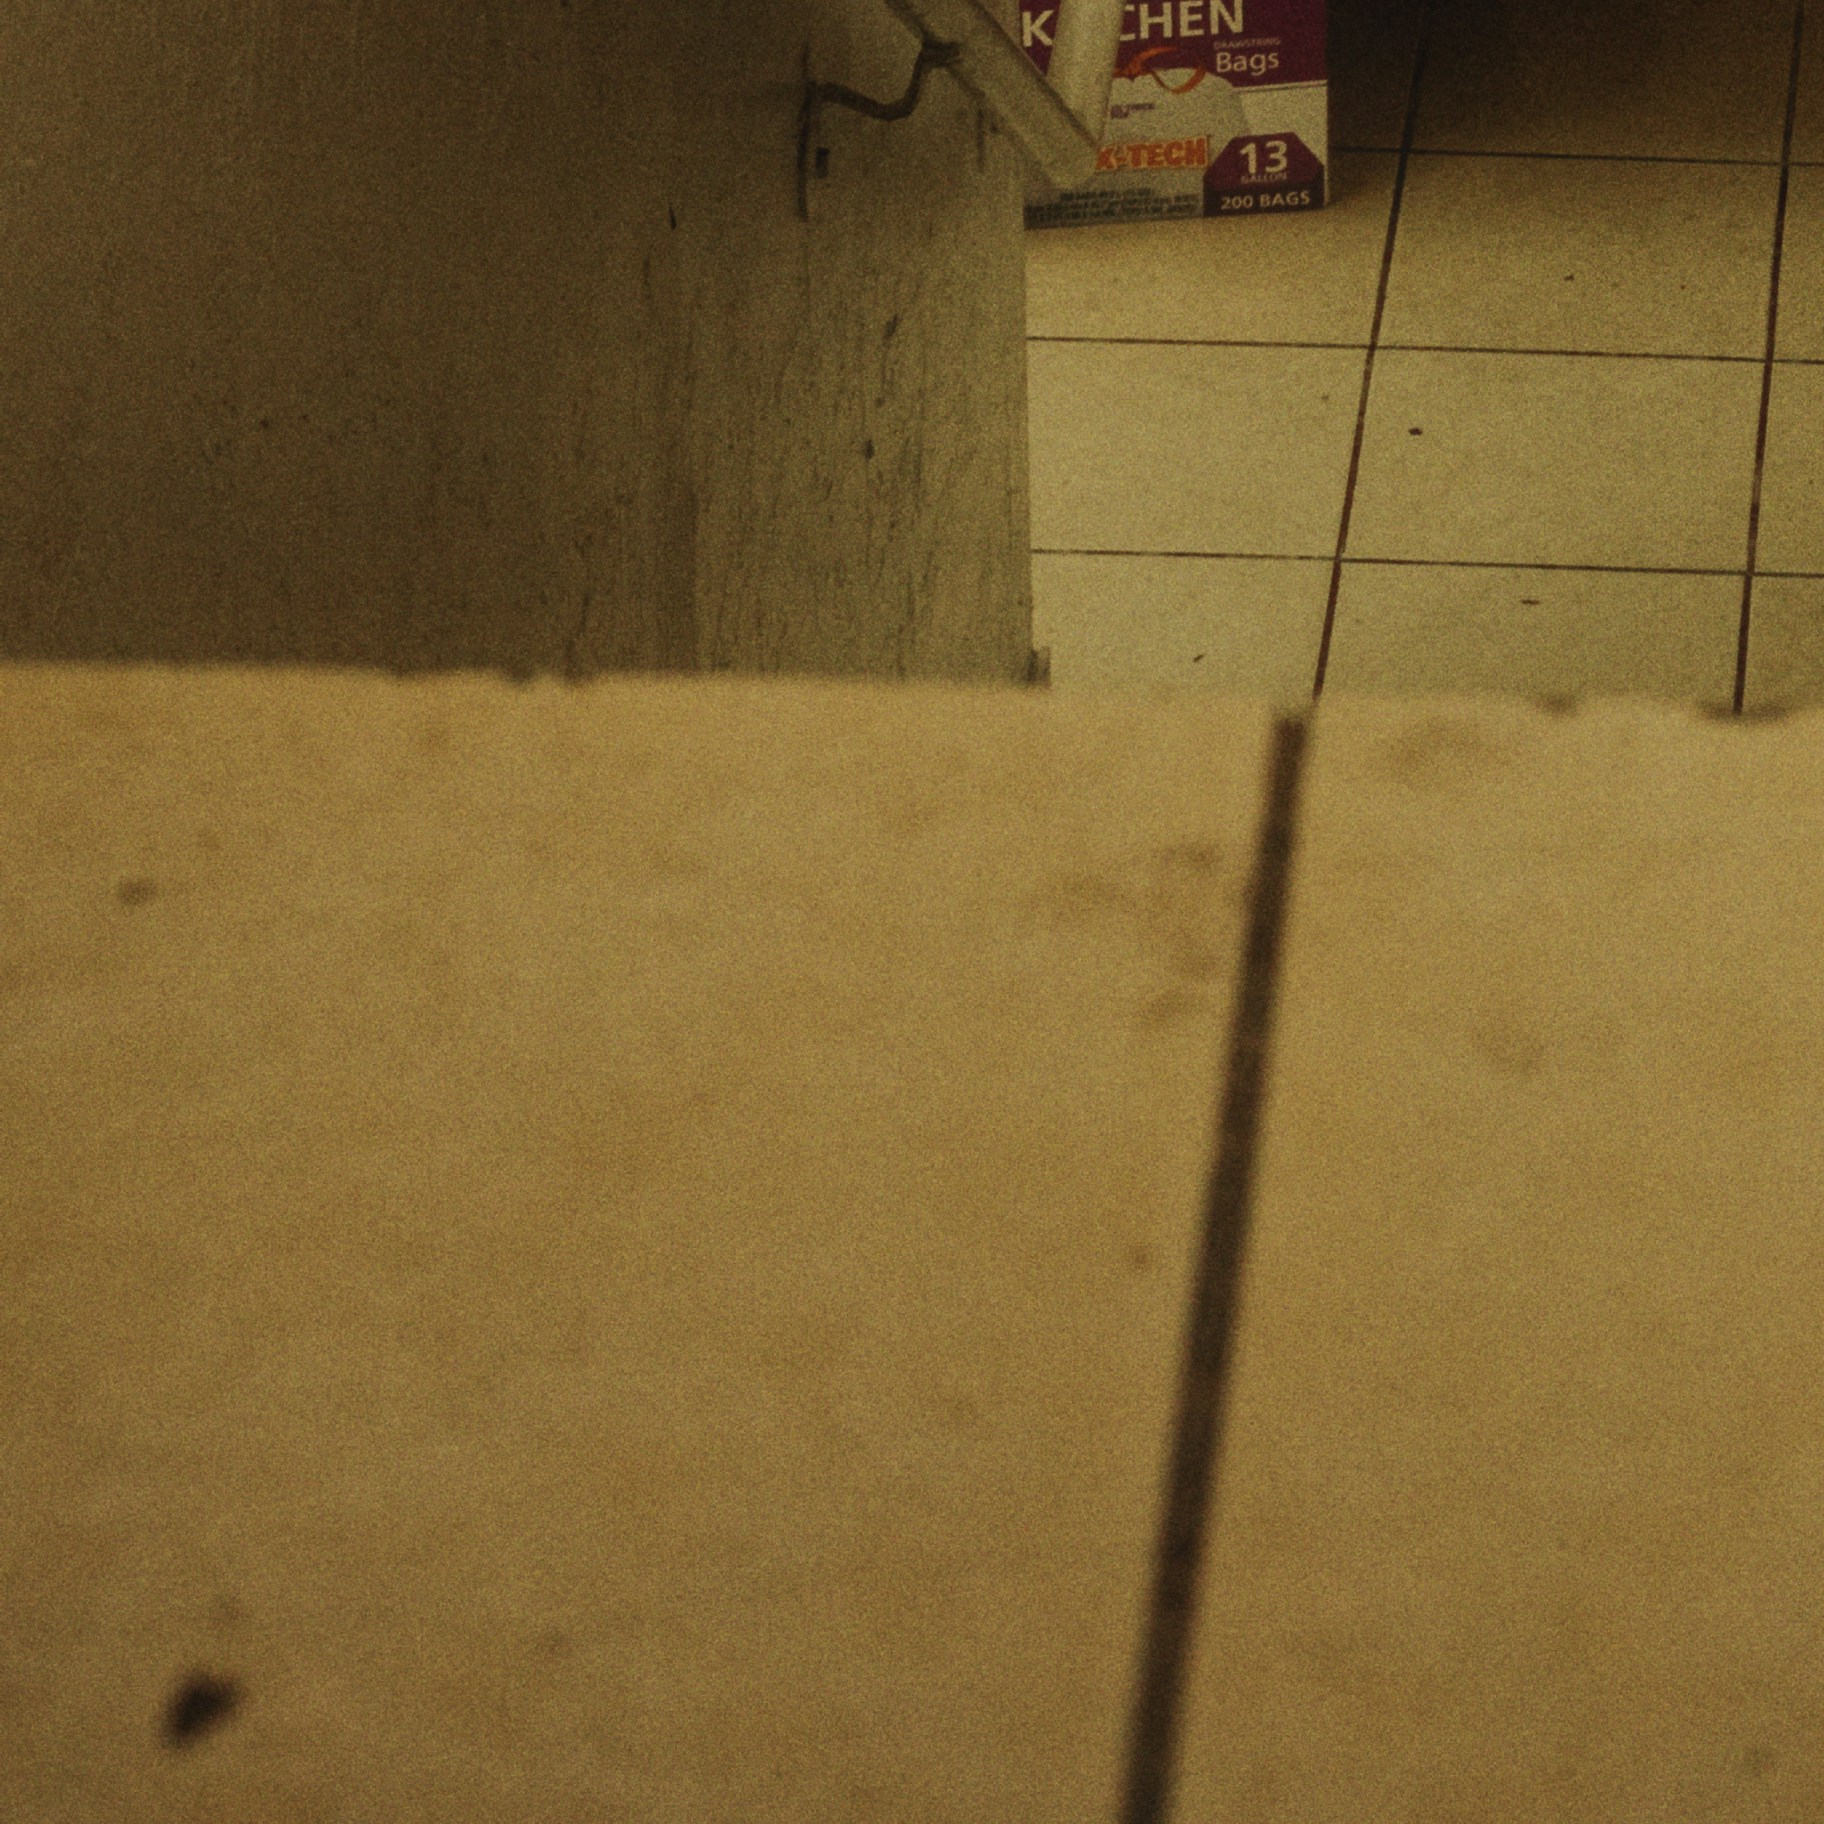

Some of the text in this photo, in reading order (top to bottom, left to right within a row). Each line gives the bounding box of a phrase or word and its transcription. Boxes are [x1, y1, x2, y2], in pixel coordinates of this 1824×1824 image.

[1216, 51, 1280, 77] Bags
[1240, 139, 1288, 174] 13
[1240, 172, 1288, 184] GALLON
[1220, 194, 1254, 211] 200
[1259, 190, 1311, 209] BAGS
